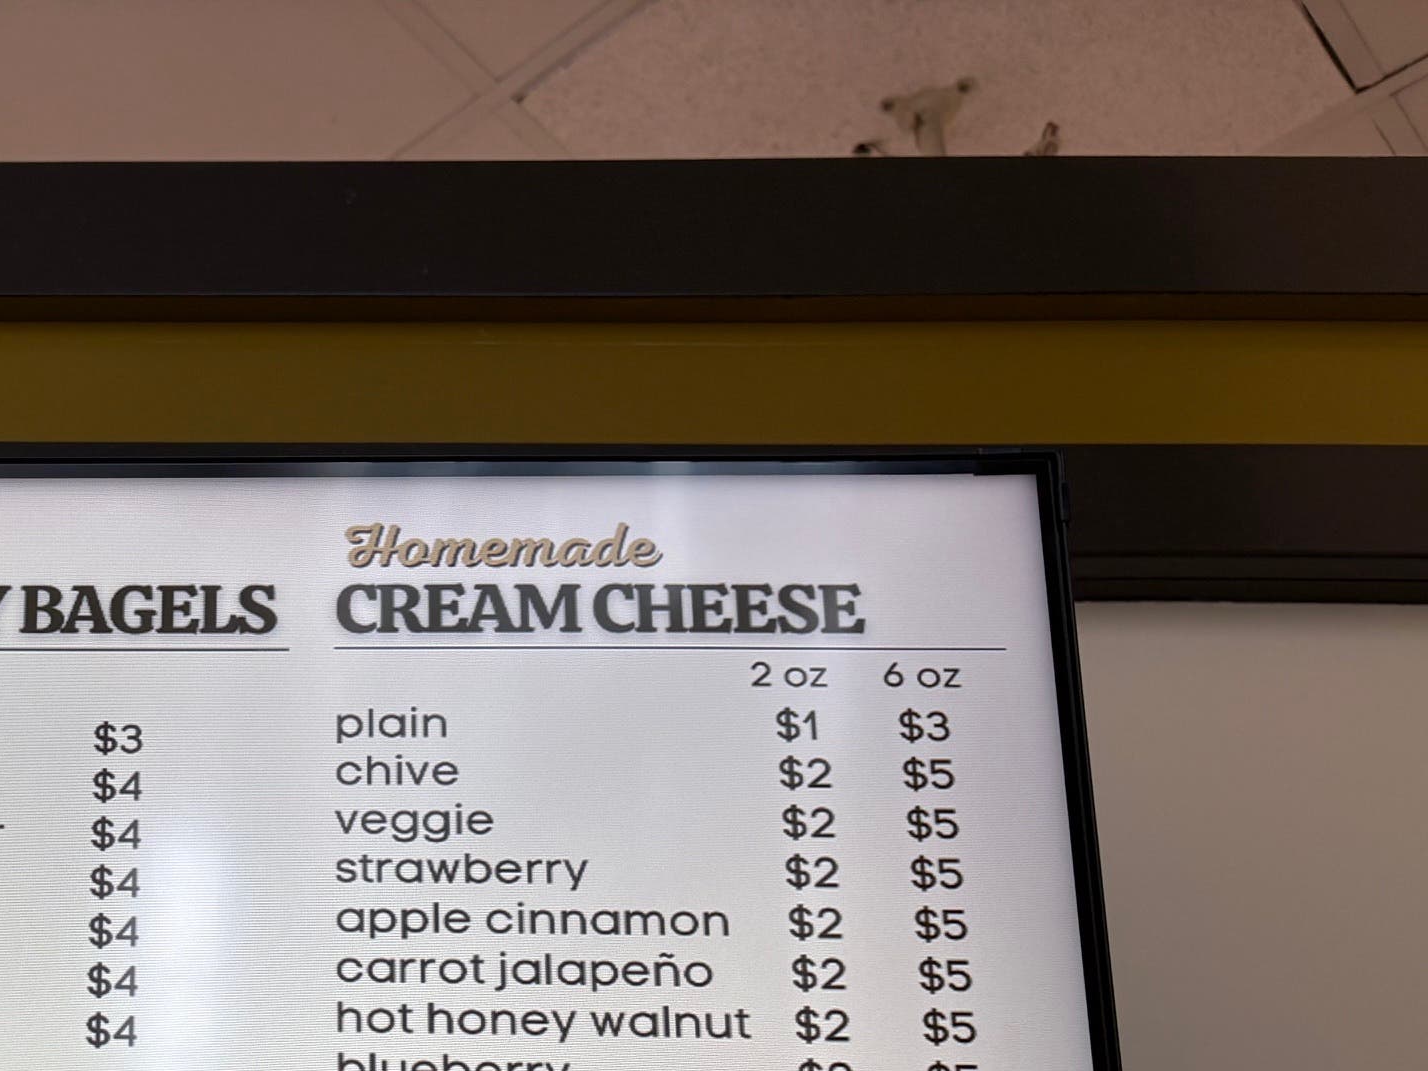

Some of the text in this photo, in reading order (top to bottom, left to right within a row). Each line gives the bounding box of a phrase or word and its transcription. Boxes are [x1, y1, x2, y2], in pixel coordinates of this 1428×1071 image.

[343, 521, 664, 569] Homemade
[18, 583, 279, 636] BAGELS
[335, 582, 867, 636] CREAM CHEESE
[750, 661, 962, 689] 2 oz 6 oz
[93, 720, 144, 757] $3
[336, 706, 951, 745] plain $1 $3
[91, 767, 143, 804] $4
[335, 901, 969, 944] apple cinnamon $2 $5
[336, 1000, 978, 1047] hot honey walnut $2 $5
